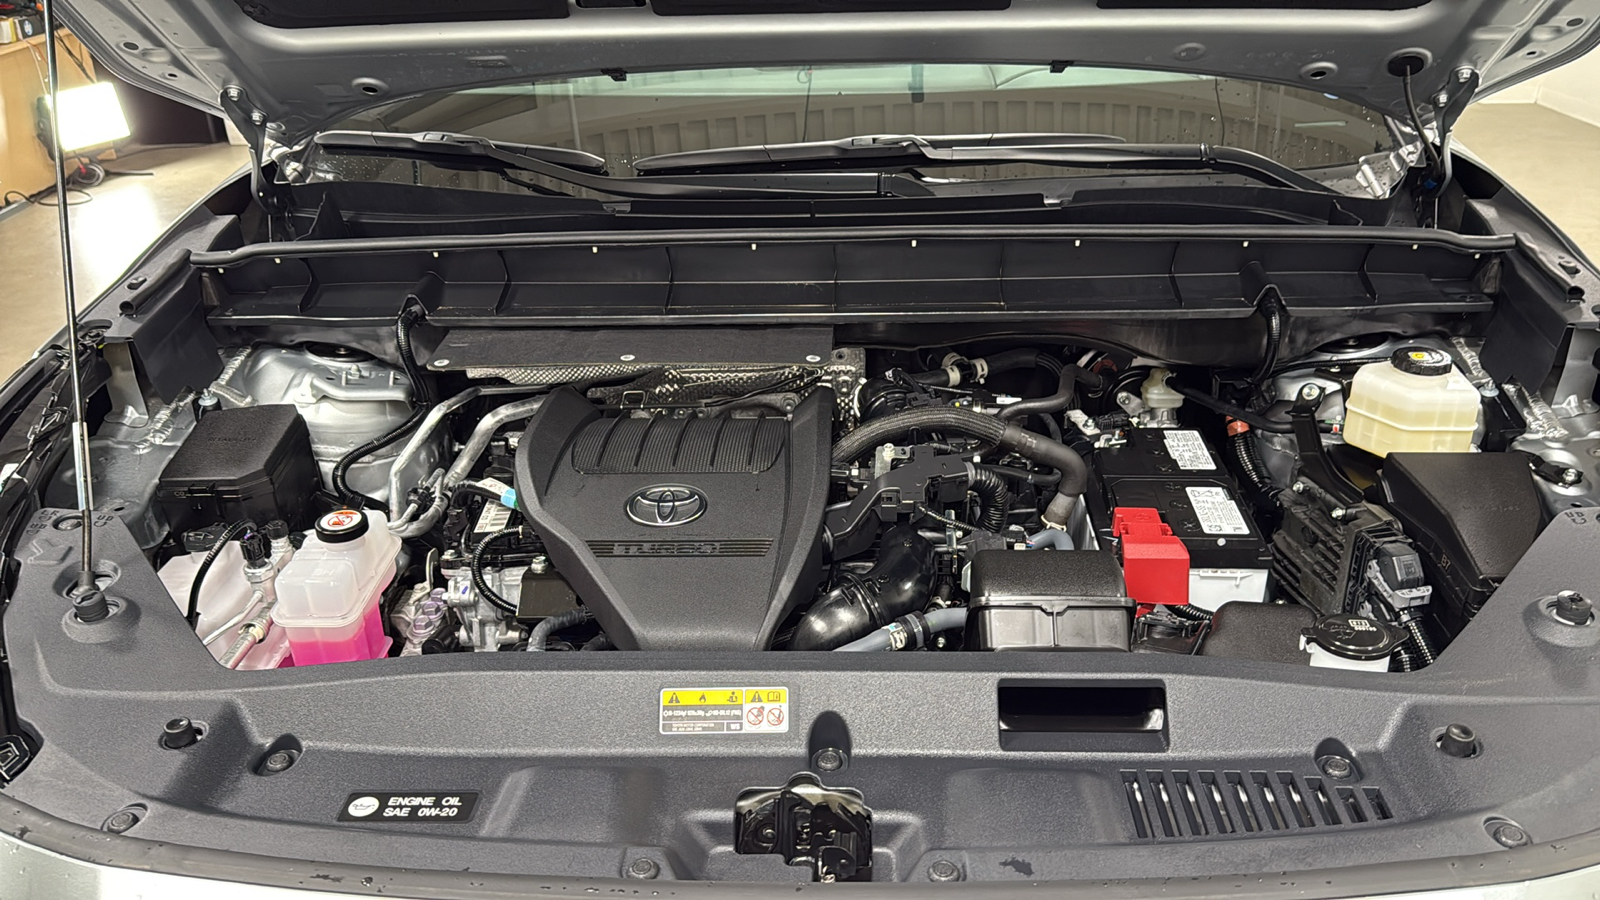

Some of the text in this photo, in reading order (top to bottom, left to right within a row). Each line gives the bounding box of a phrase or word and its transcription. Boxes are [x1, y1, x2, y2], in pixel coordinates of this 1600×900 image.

[614, 543, 719, 555] TURBO
[387, 796, 462, 806] ENGINE OIL
[383, 807, 458, 817] SAE 0W-20
